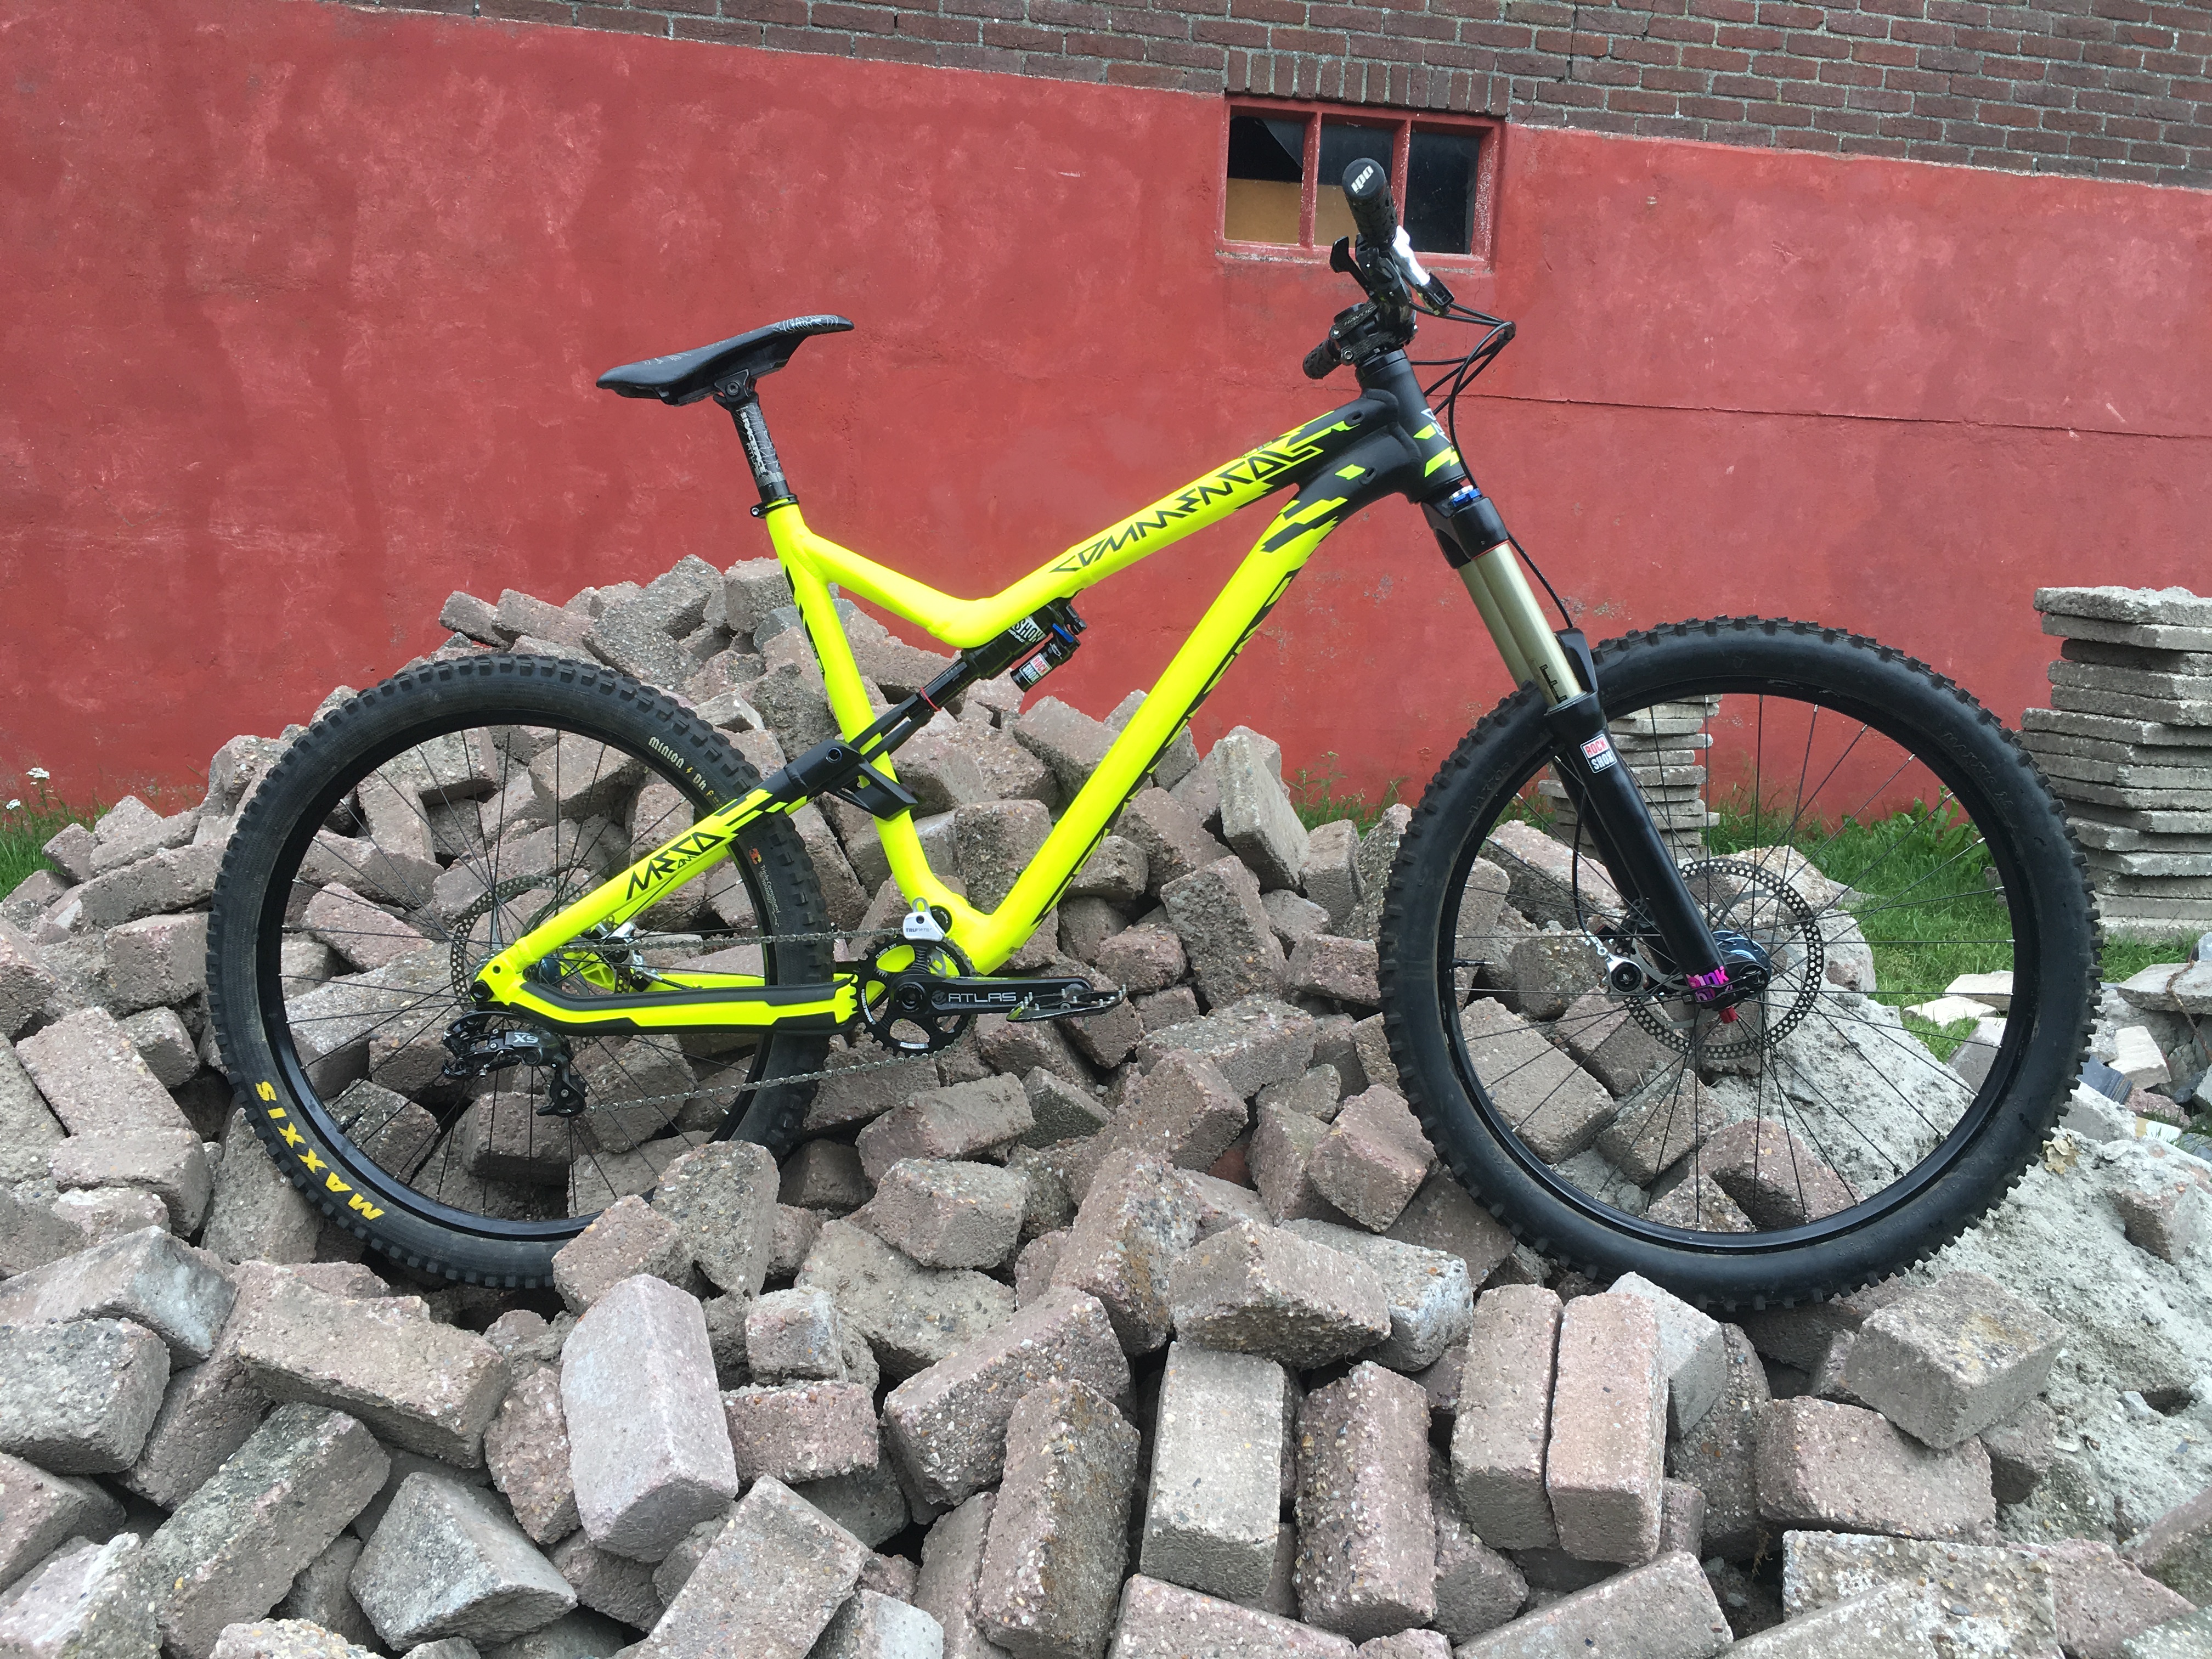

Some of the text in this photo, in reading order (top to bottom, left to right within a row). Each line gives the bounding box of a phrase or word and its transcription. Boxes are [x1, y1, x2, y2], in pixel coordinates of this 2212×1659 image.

[1049, 445, 1324, 573] COMMENCAL
[1022, 664, 1040, 682] SHOX
[1032, 657, 1049, 674] ROCK
[1584, 738, 1607, 757] ROCK
[1591, 751, 1615, 770] SHOX
[768, 881, 781, 913] Compound
[948, 992, 1017, 1002] ATLAS
[513, 1034, 539, 1043] X9
[255, 1081, 385, 1221] MAXXIS
